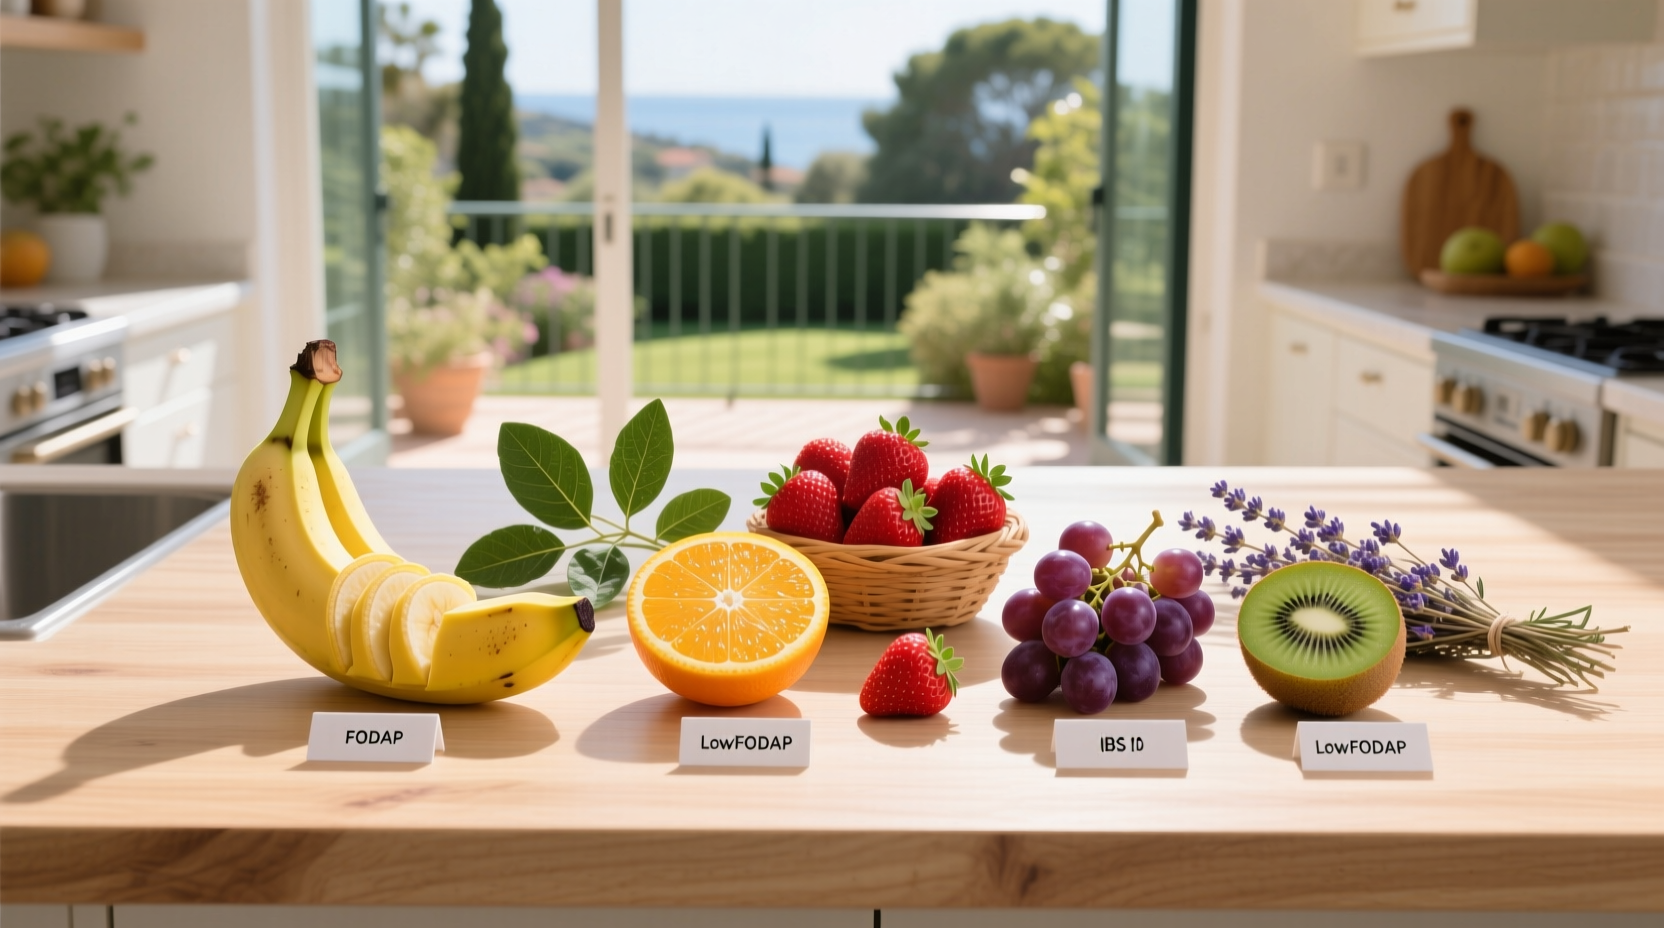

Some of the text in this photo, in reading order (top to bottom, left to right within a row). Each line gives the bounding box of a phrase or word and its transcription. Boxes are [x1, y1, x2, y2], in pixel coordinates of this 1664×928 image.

[345, 729, 404, 745] FODAP
[700, 734, 793, 751] LowFODAP
[1100, 736, 1127, 753] IBS
[1315, 739, 1407, 755] LowFODAP
